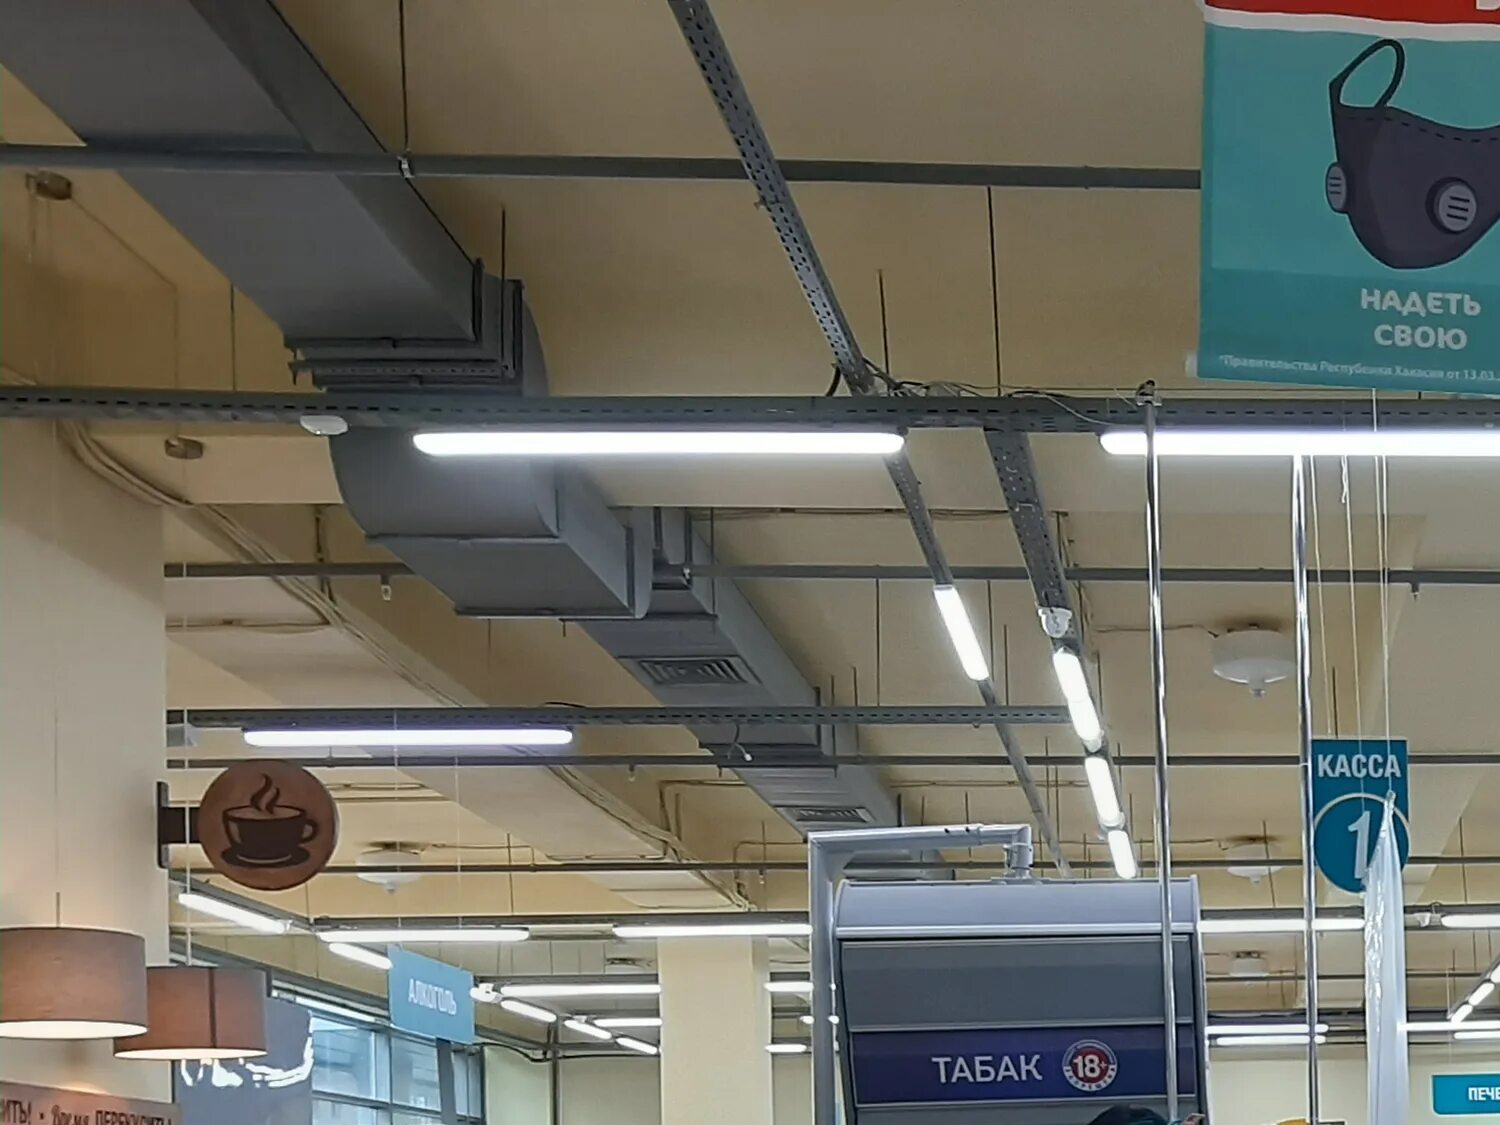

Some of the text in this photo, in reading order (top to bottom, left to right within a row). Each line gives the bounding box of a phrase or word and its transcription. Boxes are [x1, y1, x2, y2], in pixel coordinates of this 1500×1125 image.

[1360, 288, 1482, 318] НАДЕТЬ
[1374, 324, 1468, 350] СВОЮ
[1317, 753, 1401, 778] КАССА
[1348, 810, 1371, 879] 1
[931, 1054, 1043, 1084] ТАБАК
[1073, 1054, 1108, 1079] 18+
